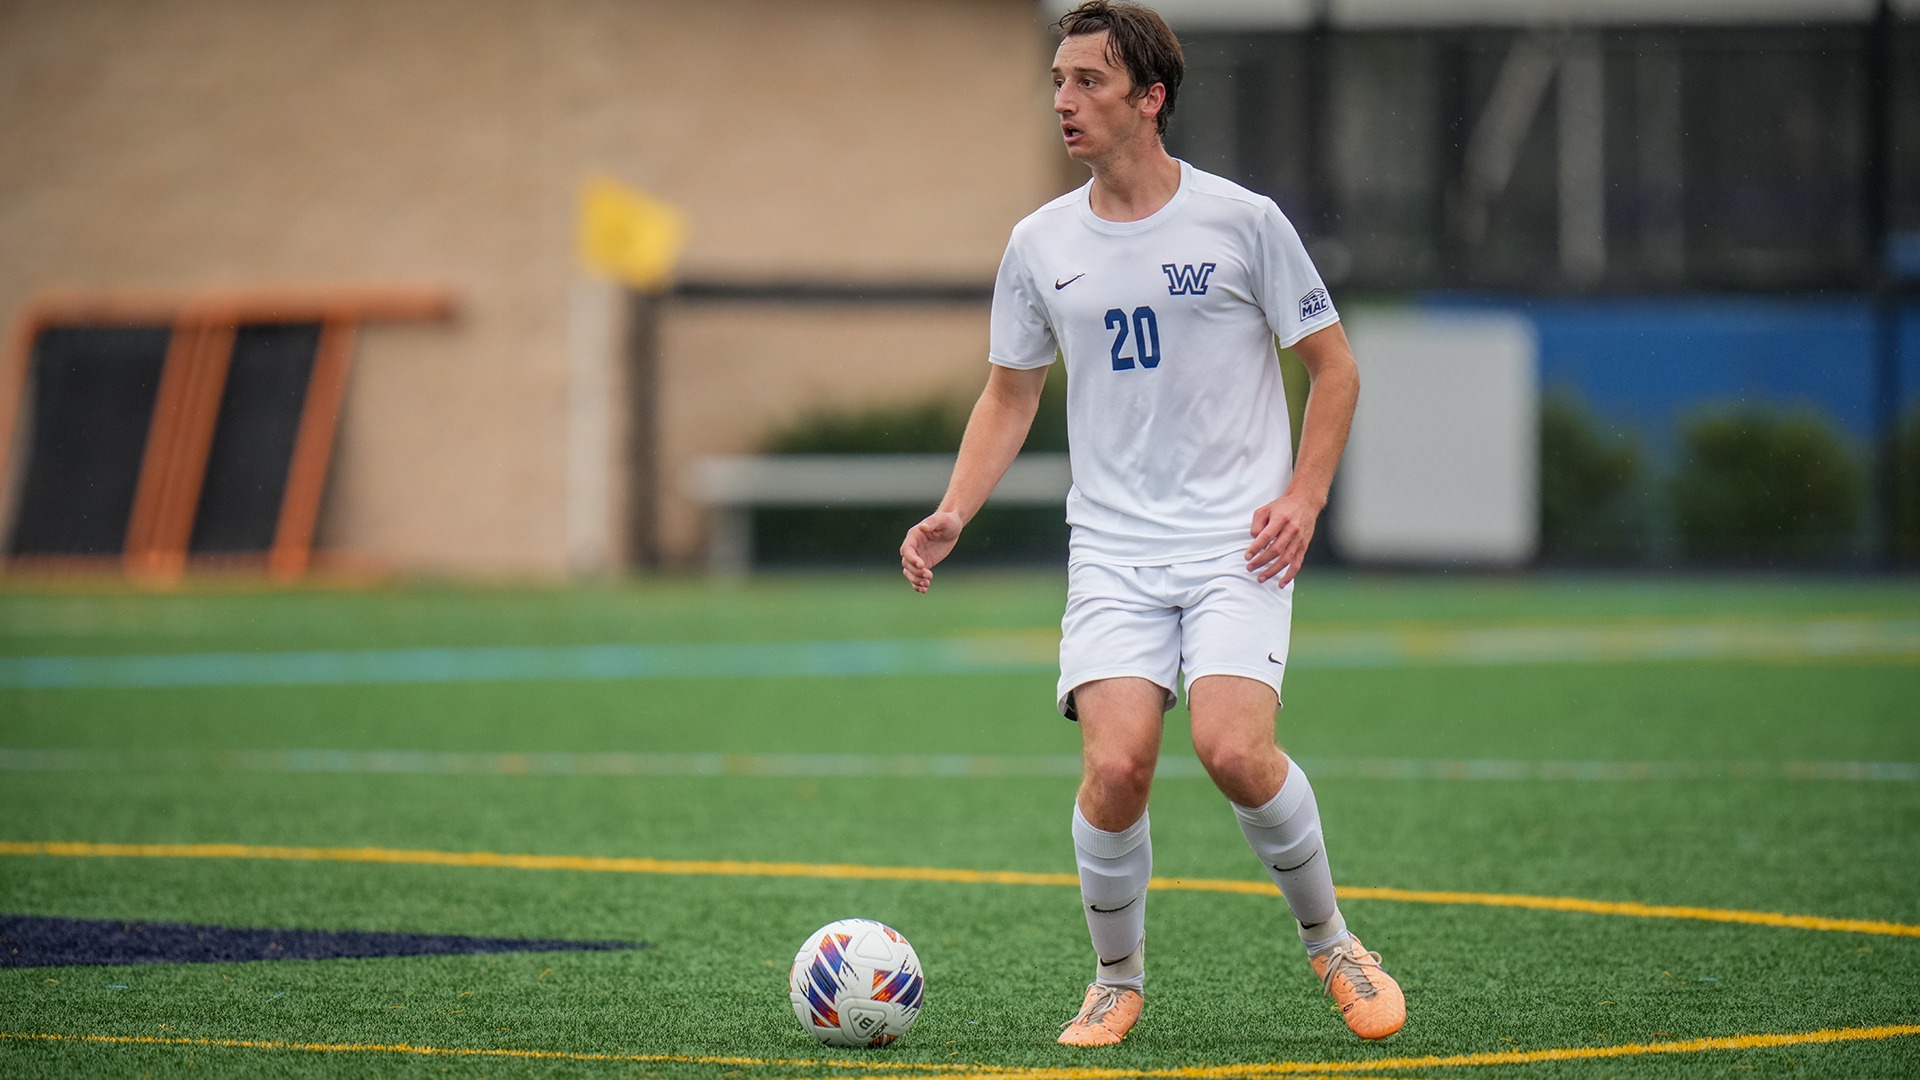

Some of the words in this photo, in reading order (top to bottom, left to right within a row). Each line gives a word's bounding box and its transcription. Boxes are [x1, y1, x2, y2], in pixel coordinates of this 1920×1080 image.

[1161, 262, 1216, 295] W
[1302, 298, 1327, 318] MAC
[1104, 306, 1161, 371] 20
